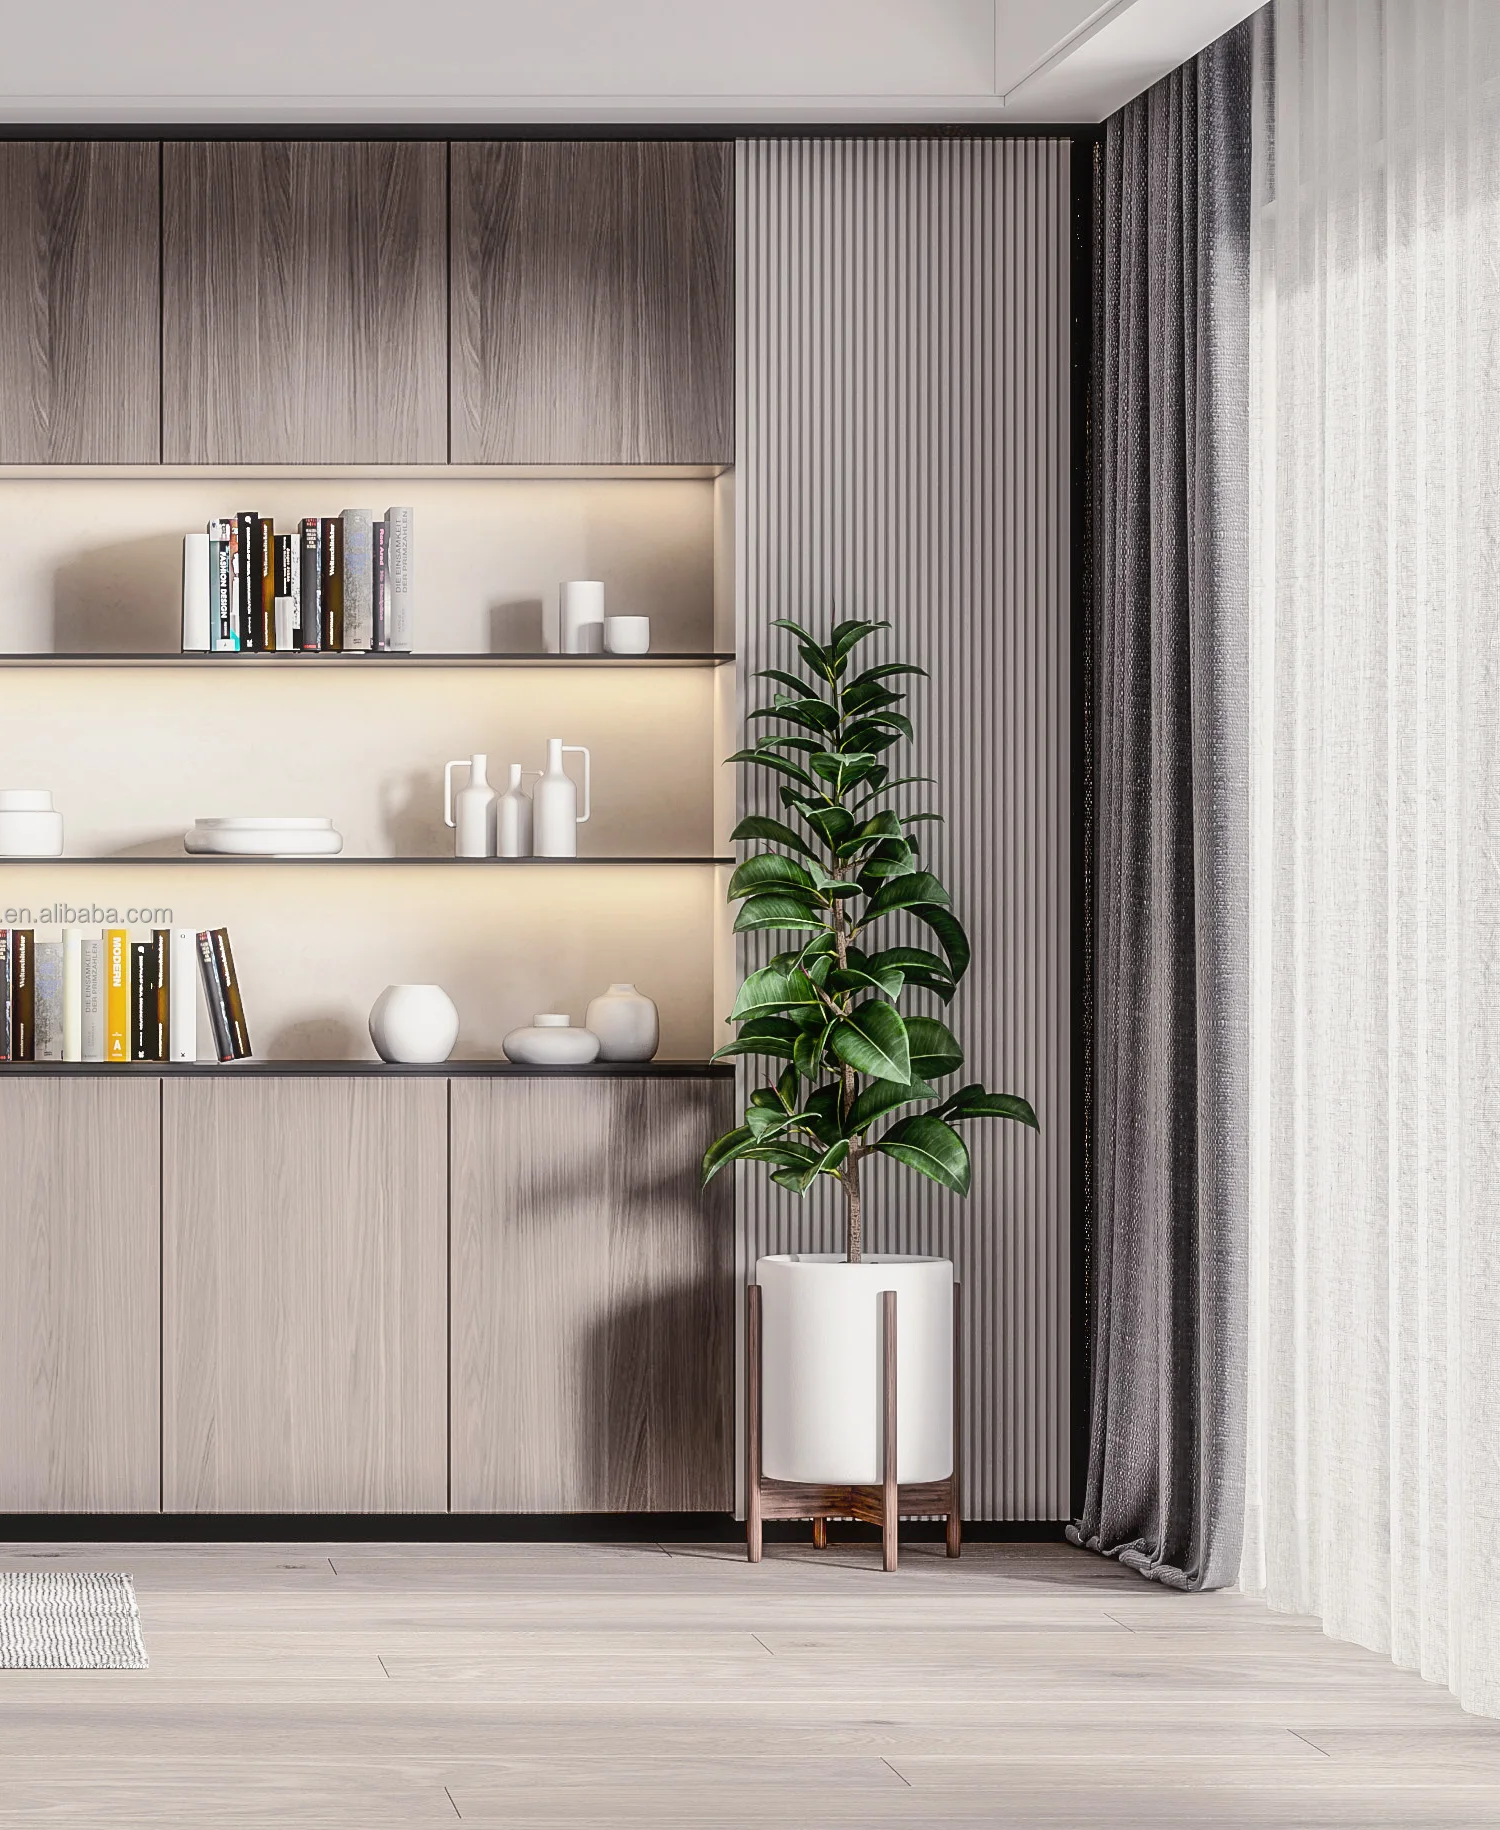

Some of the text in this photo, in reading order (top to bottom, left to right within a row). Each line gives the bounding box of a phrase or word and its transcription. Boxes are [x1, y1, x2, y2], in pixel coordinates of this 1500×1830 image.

[219, 551, 228, 587] FASHION
[219, 588, 228, 618] DESIGN
[112, 937, 121, 987] MODERN
